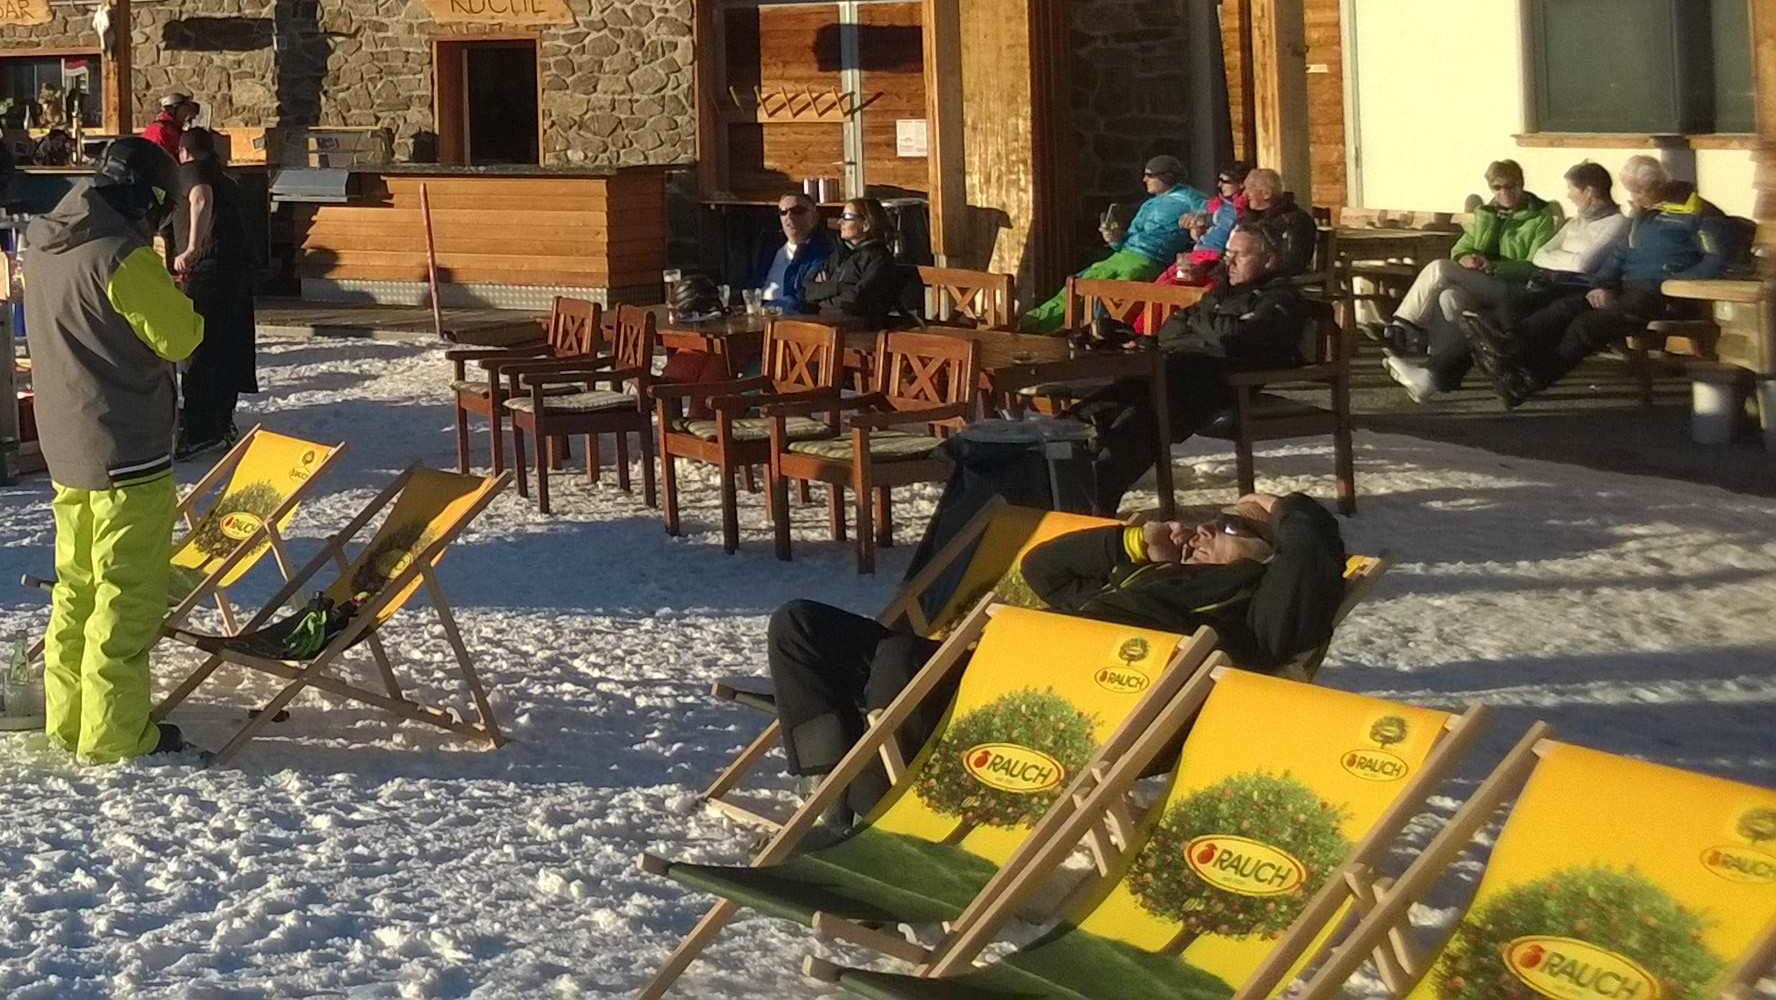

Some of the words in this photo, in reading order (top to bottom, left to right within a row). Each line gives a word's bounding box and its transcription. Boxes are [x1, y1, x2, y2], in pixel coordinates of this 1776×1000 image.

[1107, 671, 1145, 689] RAUCH
[987, 753, 1053, 785] RAUCH
[1356, 755, 1403, 777] RAUCH
[1212, 848, 1293, 888] RAUCH
[1538, 951, 1642, 1000] RAUCH
